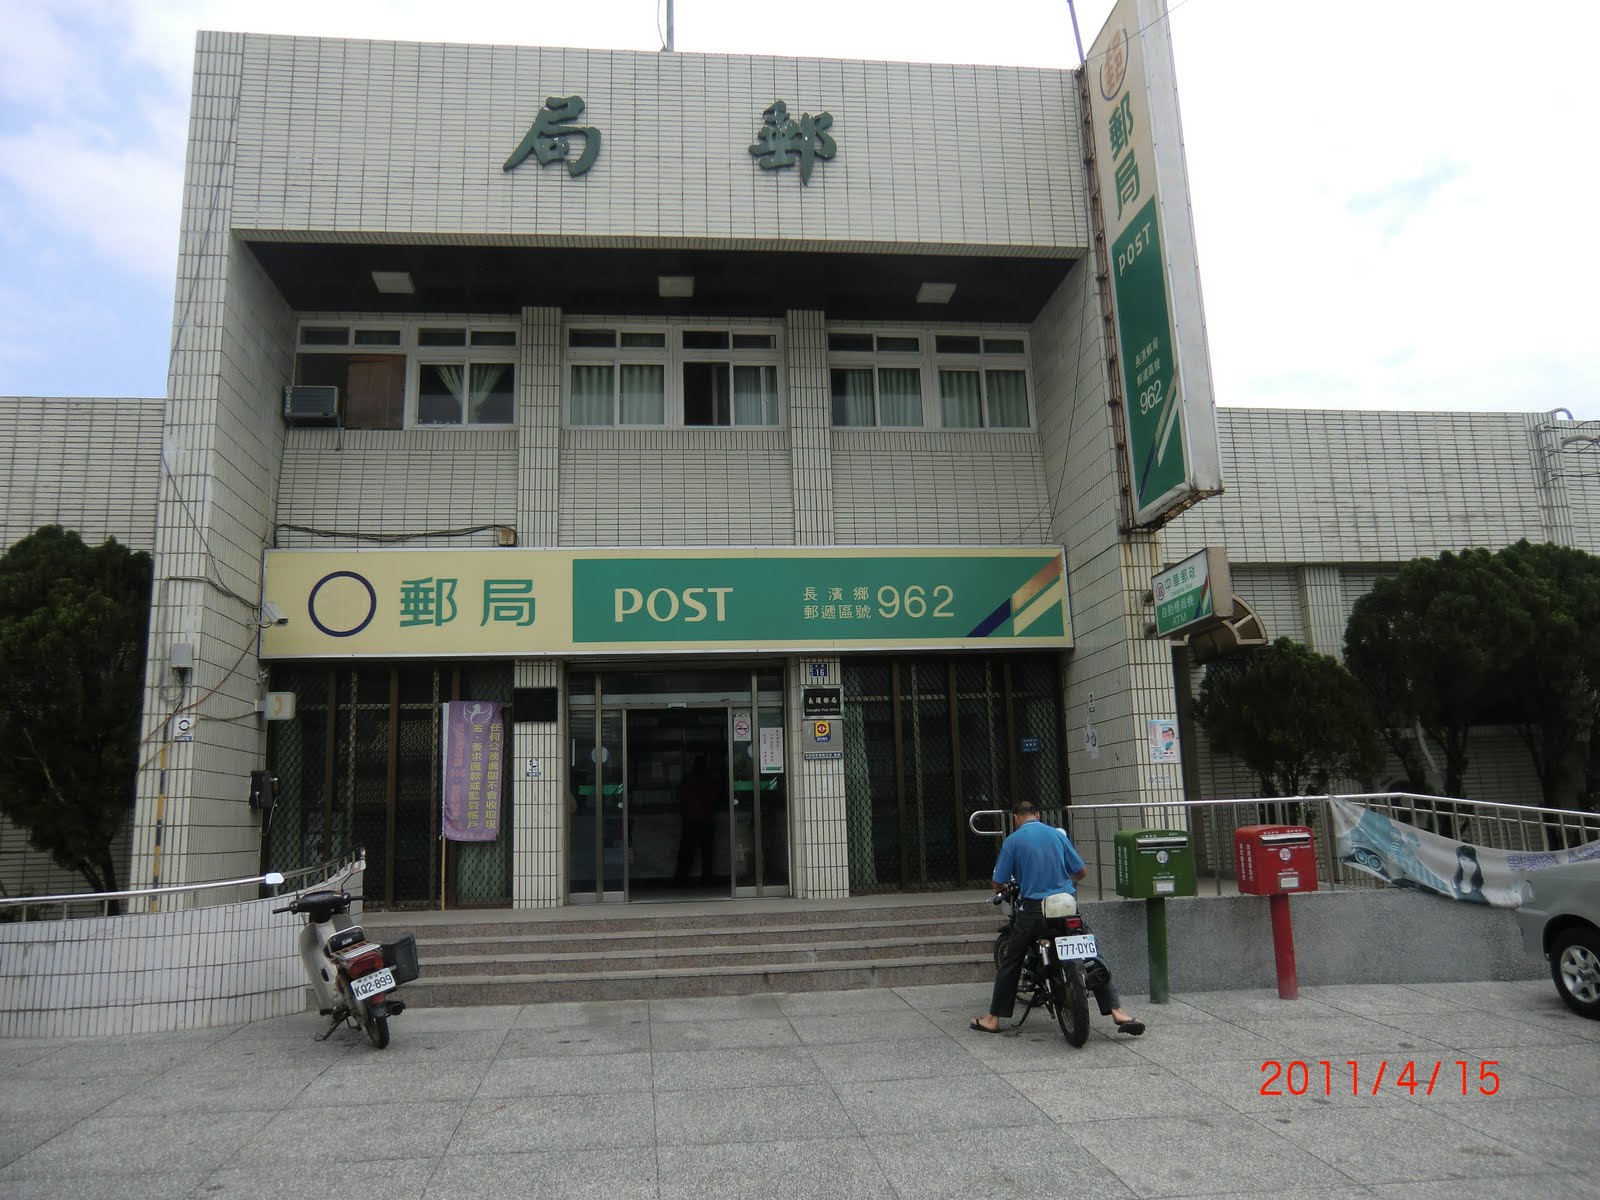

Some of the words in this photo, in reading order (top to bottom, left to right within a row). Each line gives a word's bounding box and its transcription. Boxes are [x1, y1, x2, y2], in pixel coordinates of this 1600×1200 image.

[1109, 91, 1140, 221] 郵局
[1118, 222, 1151, 277] POST
[1140, 379, 1163, 415] 962
[399, 576, 536, 628] 郵局
[614, 587, 734, 623] POST
[803, 586, 870, 601] 長濱鄉
[877, 585, 955, 619] 962
[803, 604, 873, 620] 郵遞區號
[1172, 613, 1188, 627] ATM
[815, 669, 825, 677] 16
[354, 974, 393, 997] KQ2-899
